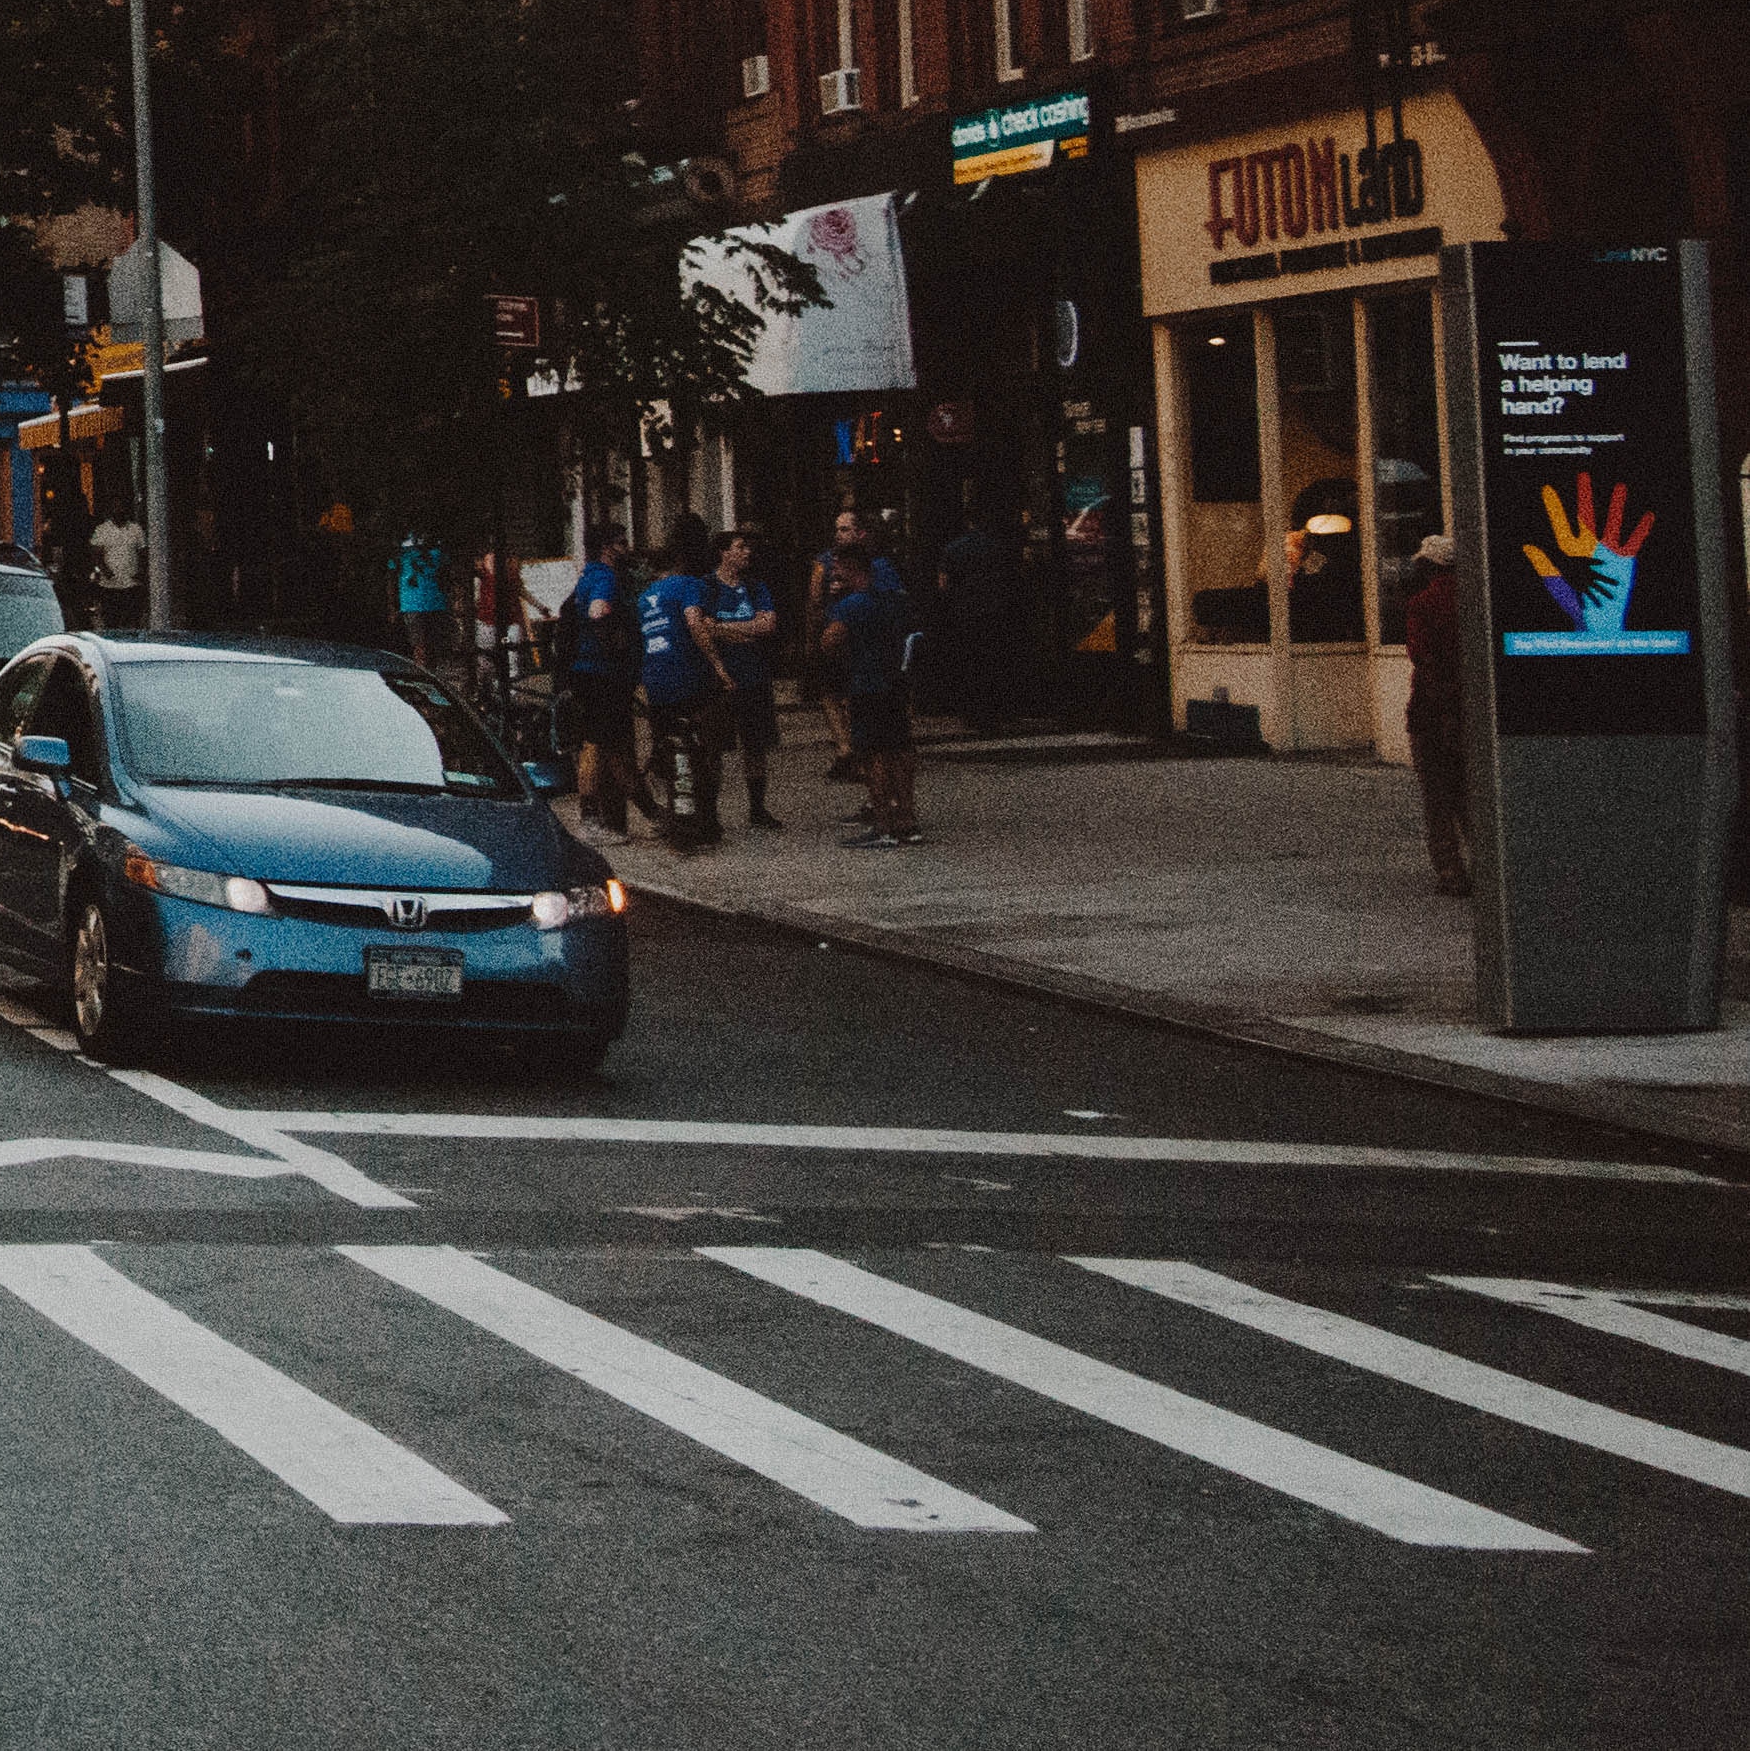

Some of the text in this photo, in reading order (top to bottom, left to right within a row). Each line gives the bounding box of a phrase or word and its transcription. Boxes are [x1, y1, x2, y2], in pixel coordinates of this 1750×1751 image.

[1001, 104, 1039, 135] check
[1041, 93, 1089, 126] cashing
[1498, 352, 1628, 370] Want to lend
[1500, 375, 1594, 395] a helping
[1501, 397, 1565, 415] hand?
